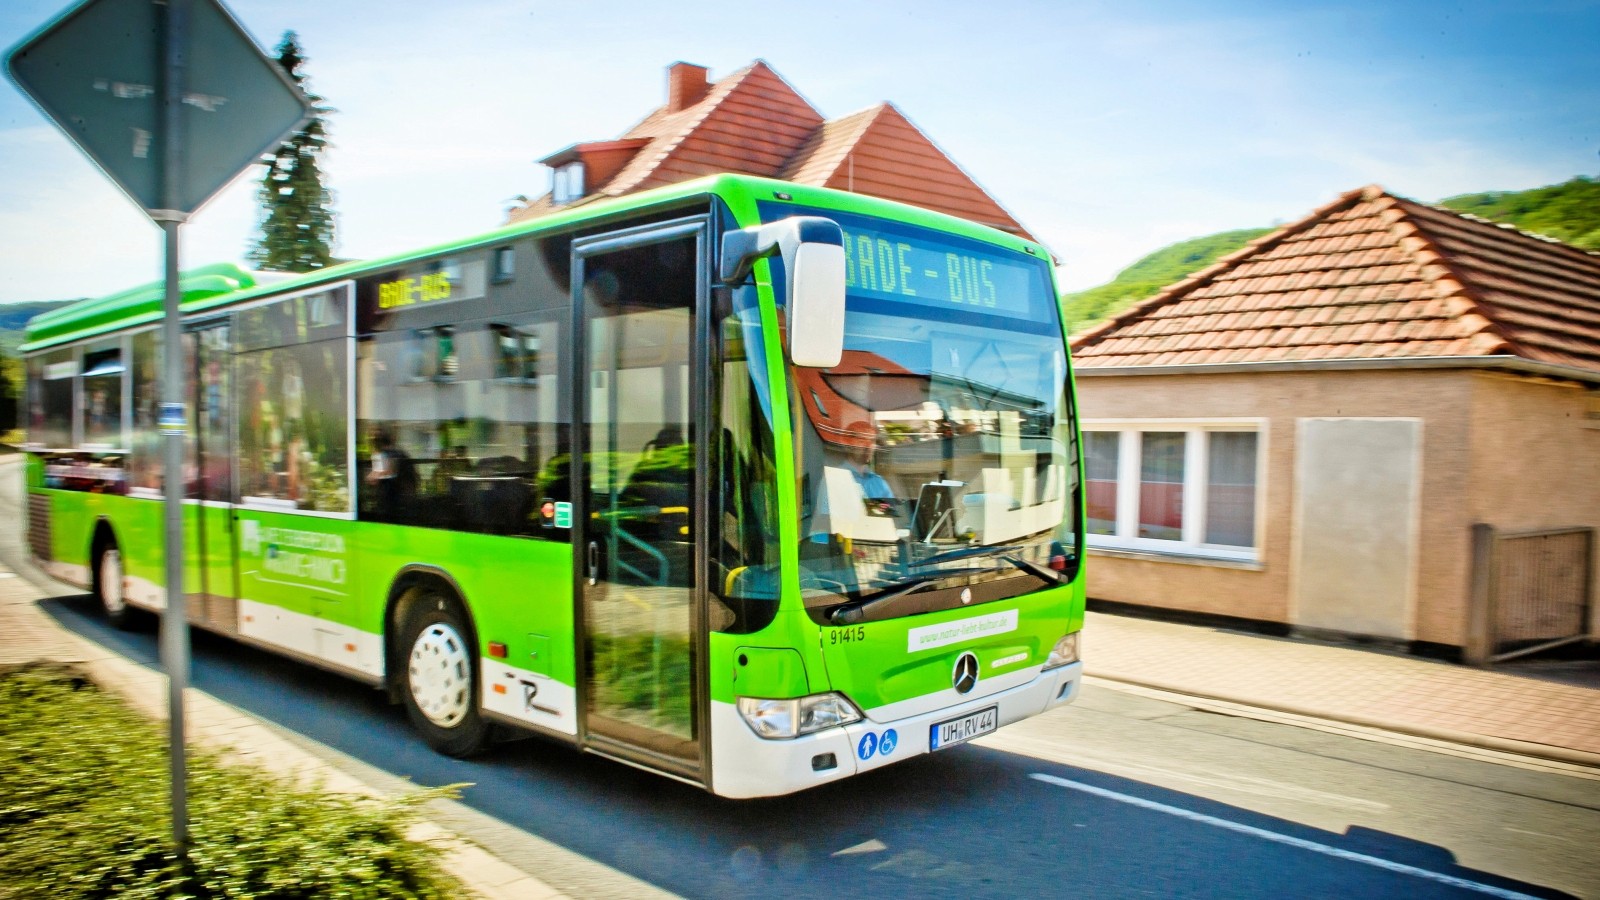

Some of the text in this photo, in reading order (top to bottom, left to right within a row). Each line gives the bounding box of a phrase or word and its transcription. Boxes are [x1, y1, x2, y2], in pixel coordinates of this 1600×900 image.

[946, 252, 996, 308] BUS
[831, 626, 865, 645] 91415
[943, 711, 992, 742] UH RV 44
